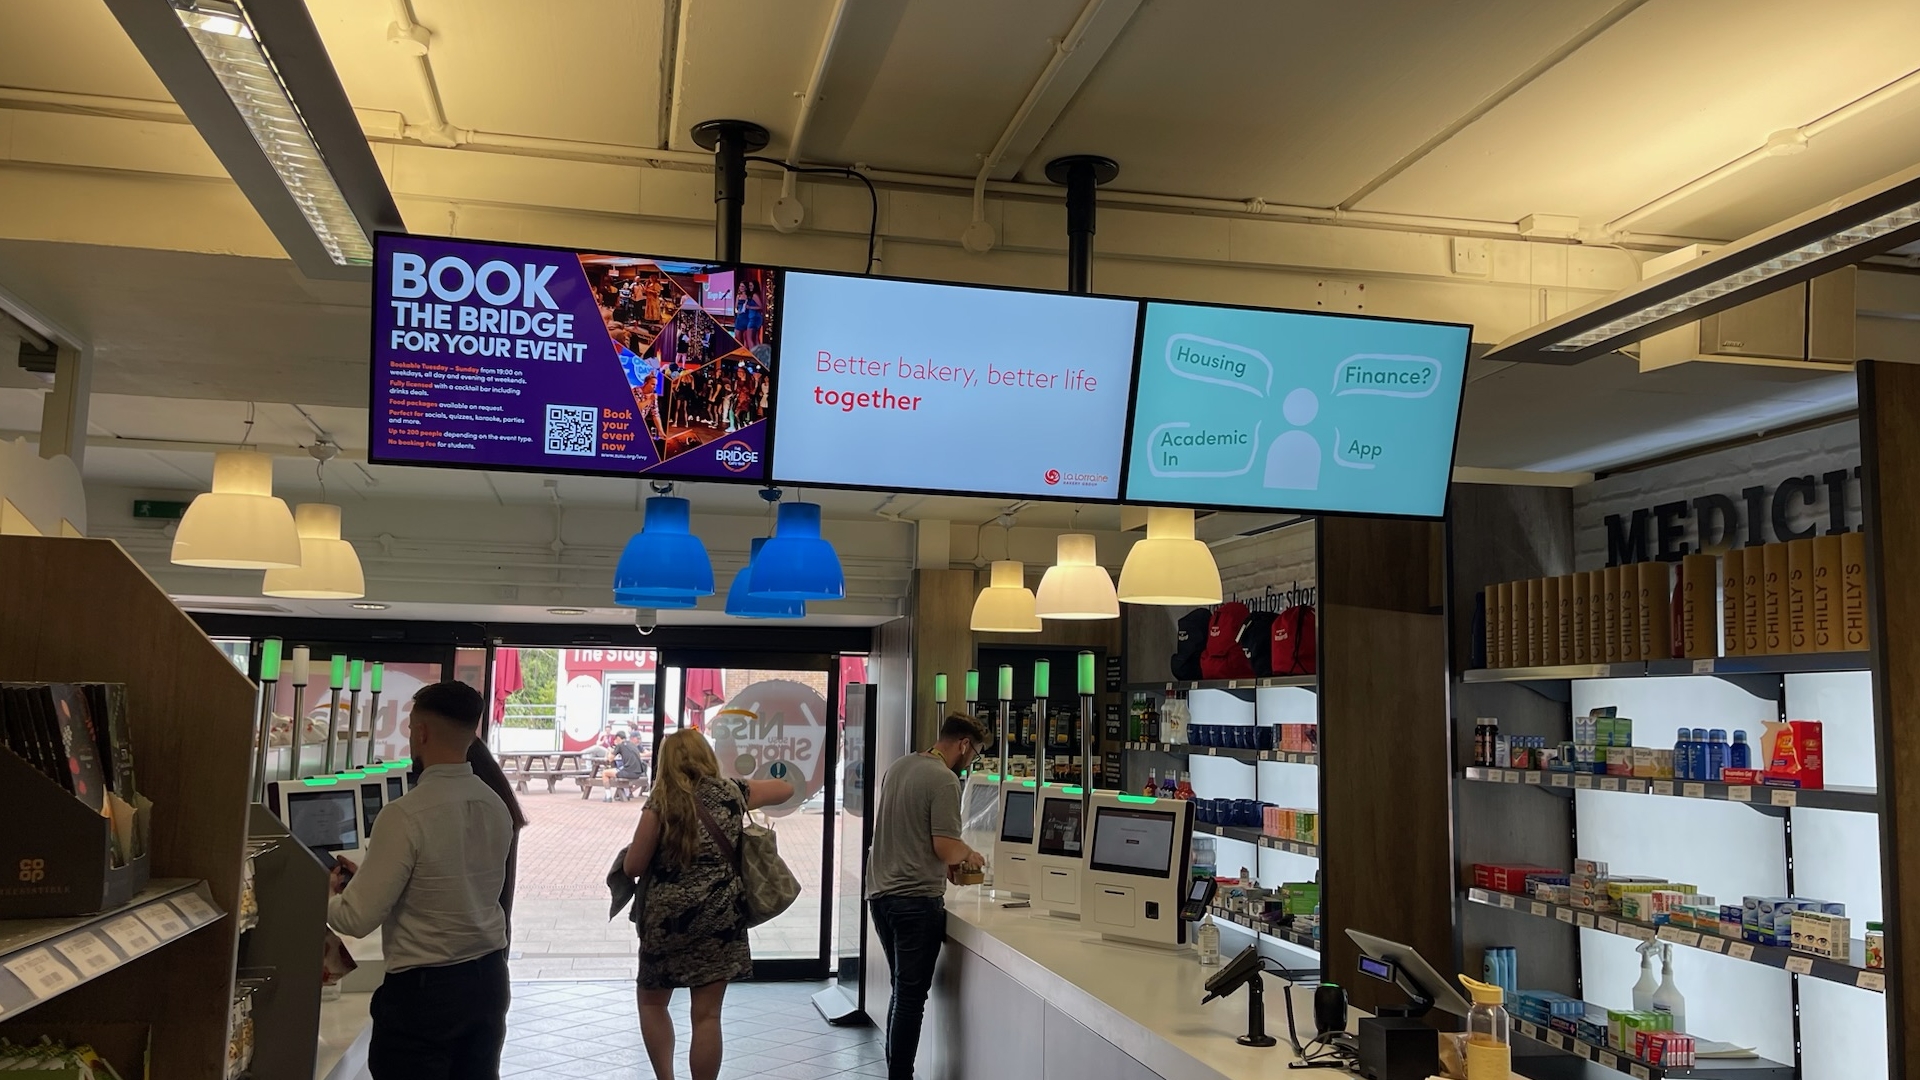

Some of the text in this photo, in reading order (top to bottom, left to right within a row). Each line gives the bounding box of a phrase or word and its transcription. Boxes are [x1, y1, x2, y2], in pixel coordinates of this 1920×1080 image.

[392, 252, 559, 309] BOOK
[391, 301, 574, 339] THE BRIDGE
[391, 330, 587, 363] FOR YOUR EVENT
[390, 361, 420, 369] Bookable
[422, 363, 448, 372] Tuesday
[455, 366, 479, 374] Sunday
[1176, 346, 1246, 378] Housing
[390, 370, 423, 378] weekdays,
[817, 351, 1097, 391] Better bakery, better life
[1345, 366, 1431, 385] Finance?
[390, 380, 404, 388] Fully
[434, 382, 448, 390] with
[455, 384, 479, 392] cocktail
[492, 387, 521, 395] including
[406, 400, 438, 408] packages
[814, 386, 921, 412] together
[389, 409, 413, 417] Perfect
[475, 415, 502, 423] karaoke,
[603, 408, 632, 420] Book
[388, 428, 398, 436] Up
[420, 430, 442, 438] people
[443, 432, 477, 440] depending
[602, 421, 629, 430] your
[399, 439, 424, 447] booking
[602, 431, 634, 441] event
[1161, 430, 1247, 447] Academic
[602, 443, 625, 451] now
[1348, 440, 1382, 459] App
[716, 450, 758, 463] BRIDGE
[1163, 451, 1178, 466] In
[1075, 473, 1108, 482] Lorraine
[1604, 466, 1863, 568] MEDICI
[1266, 586, 1283, 612] for
[1816, 566, 1829, 646] CHILLY'S
[1847, 564, 1863, 645] CHILLY'S
[1766, 572, 1779, 648] CHILLY'S
[1791, 569, 1805, 647] CHILLY'S
[606, 650, 656, 667] Stags
